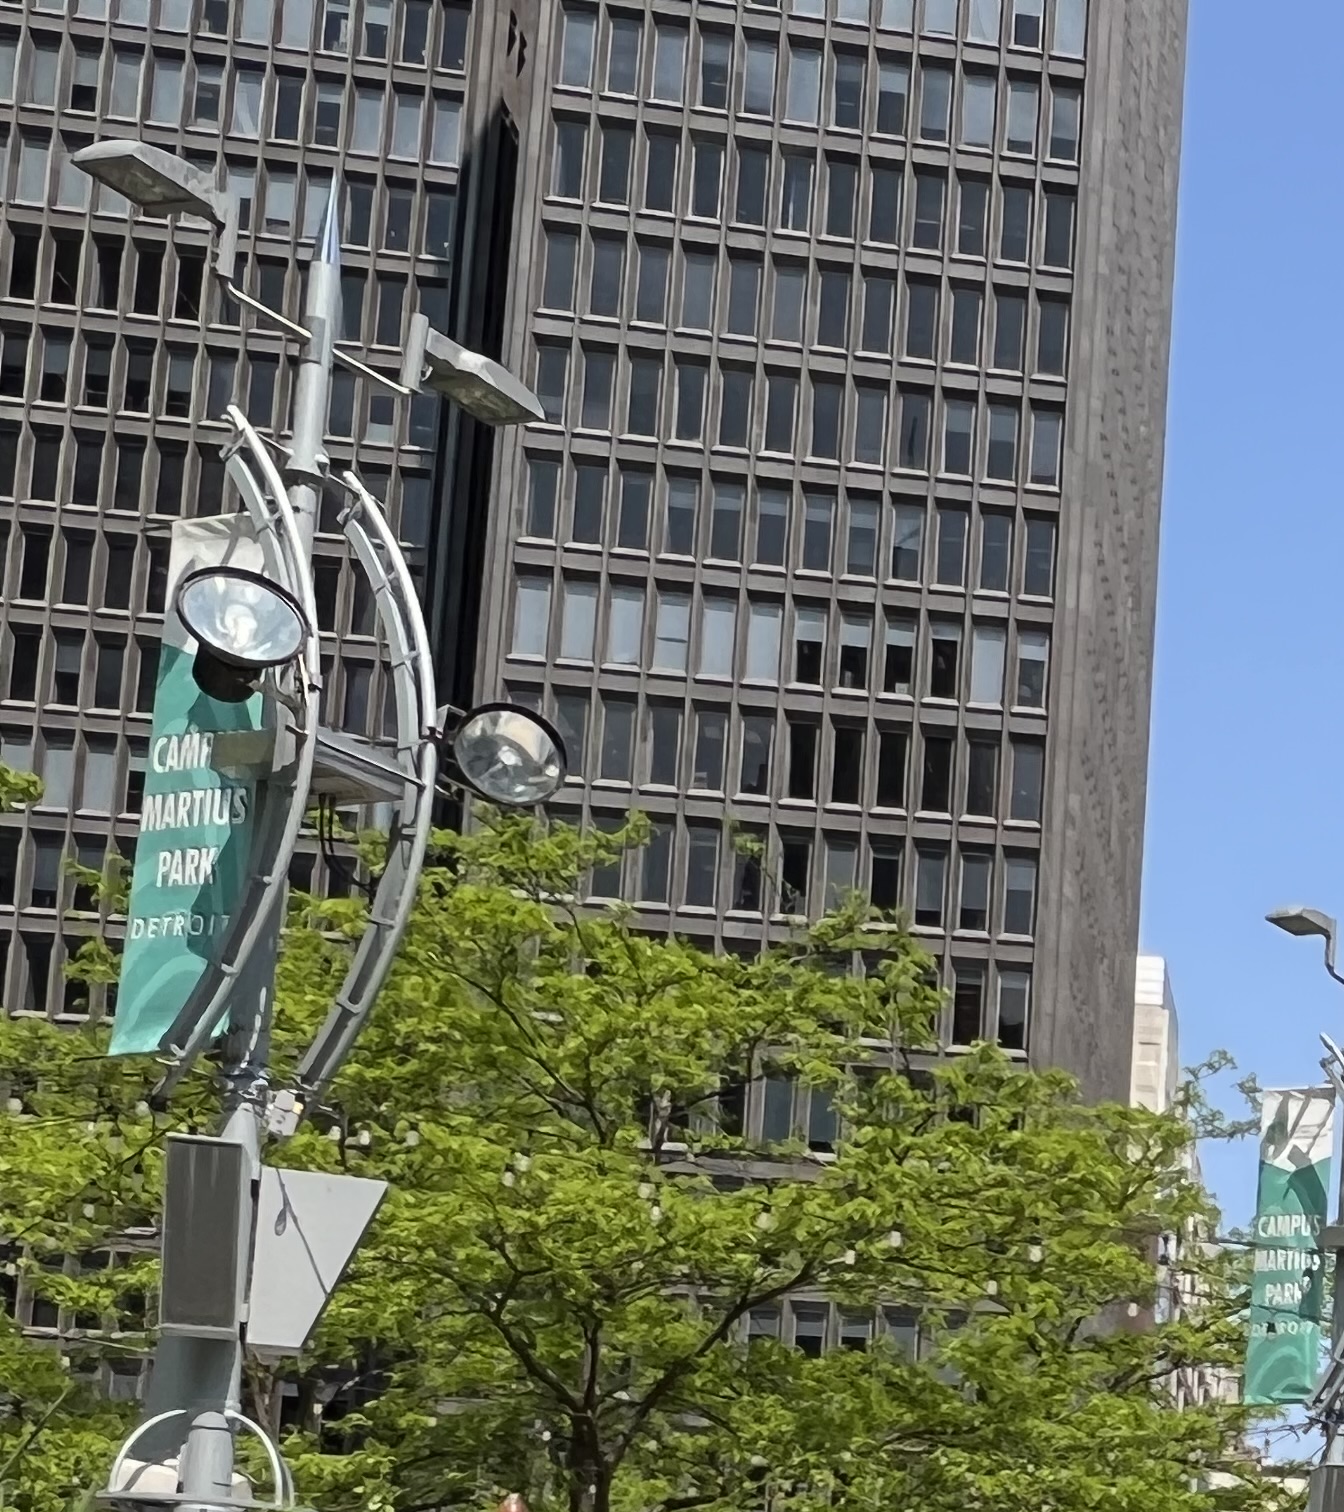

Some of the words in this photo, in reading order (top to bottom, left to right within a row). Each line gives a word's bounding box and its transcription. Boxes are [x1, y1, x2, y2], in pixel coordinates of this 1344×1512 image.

[152, 732, 214, 774] CAMP
[140, 787, 248, 832] MARTIUS
[156, 847, 218, 888] PARK
[1258, 1214, 1321, 1237] CAMPUS
